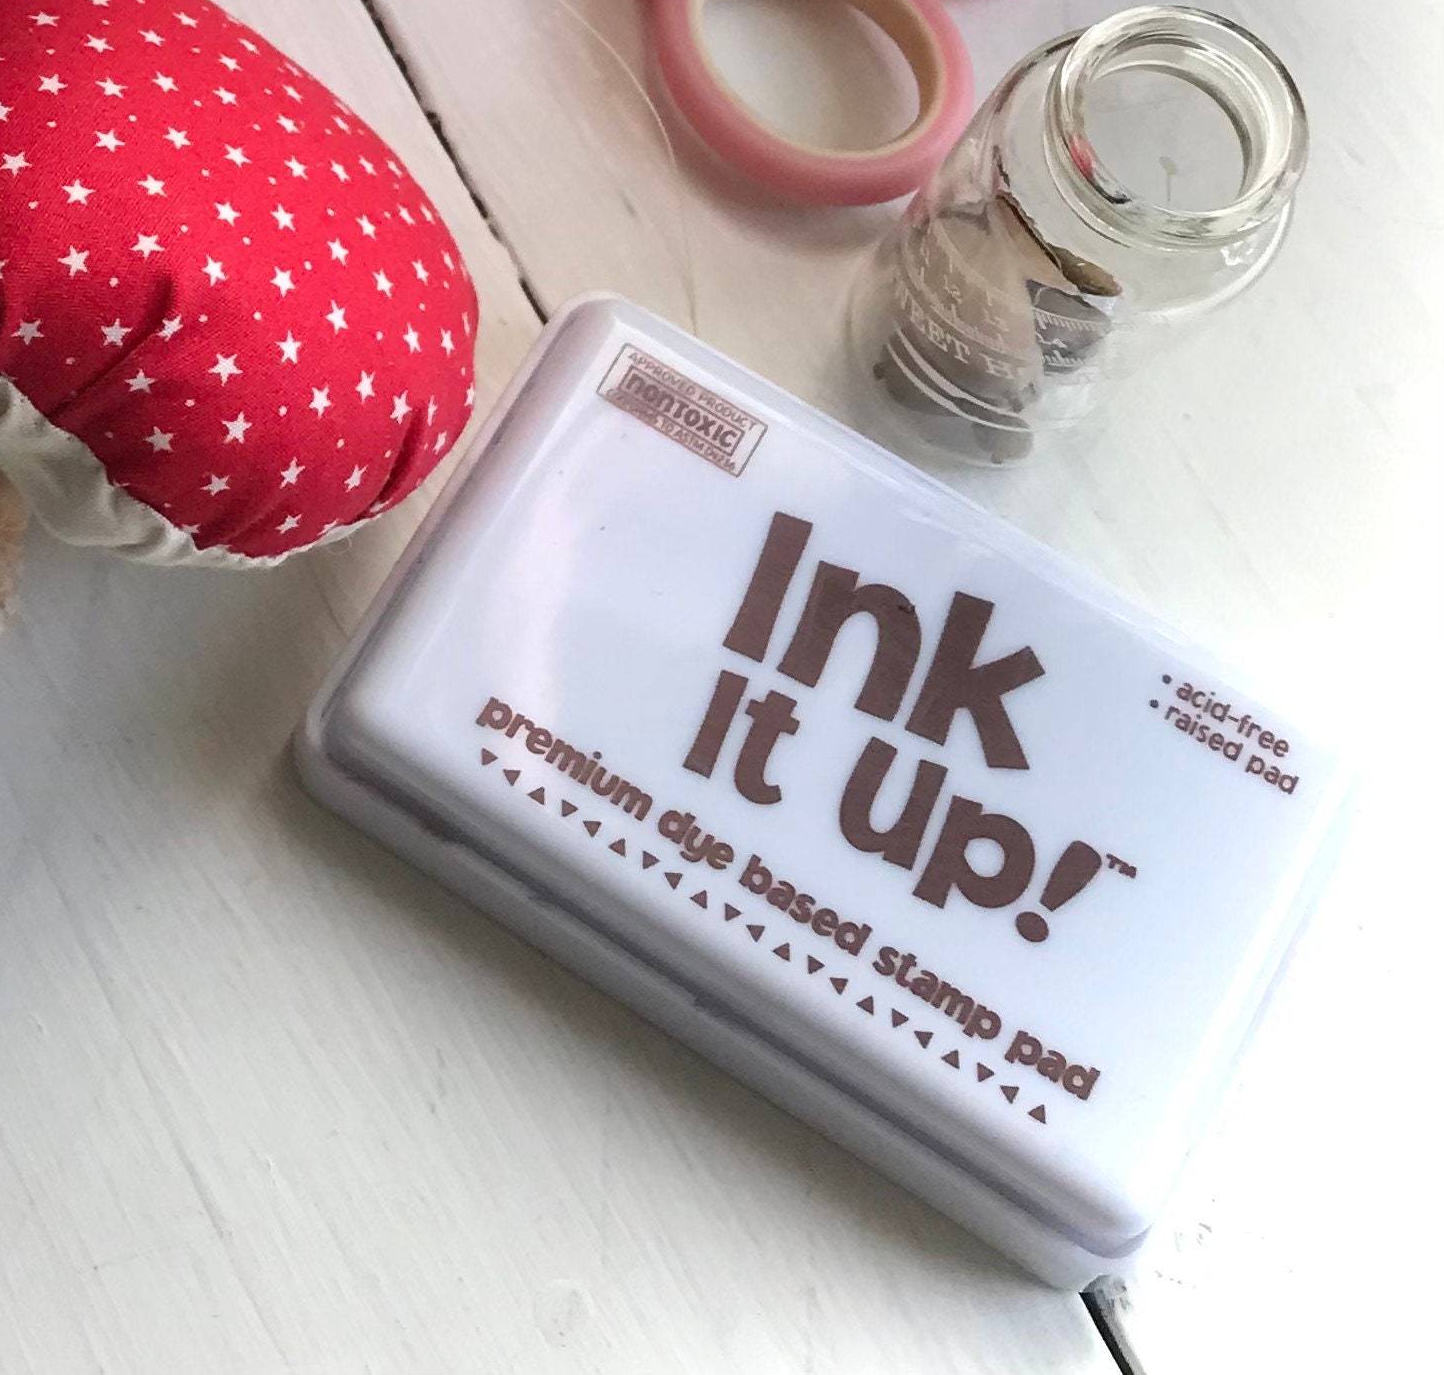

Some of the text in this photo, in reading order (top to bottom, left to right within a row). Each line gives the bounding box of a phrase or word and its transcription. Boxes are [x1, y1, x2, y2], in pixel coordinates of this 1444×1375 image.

[628, 351, 757, 431] APPROVED PRODUCT
[722, 511, 1046, 770] Ink
[1174, 677, 1290, 759] acid-free
[683, 669, 801, 805] It
[838, 736, 1102, 943] up!
[1164, 702, 1299, 796] raised pad
[475, 696, 1101, 1101] premium dye based stamp pad
